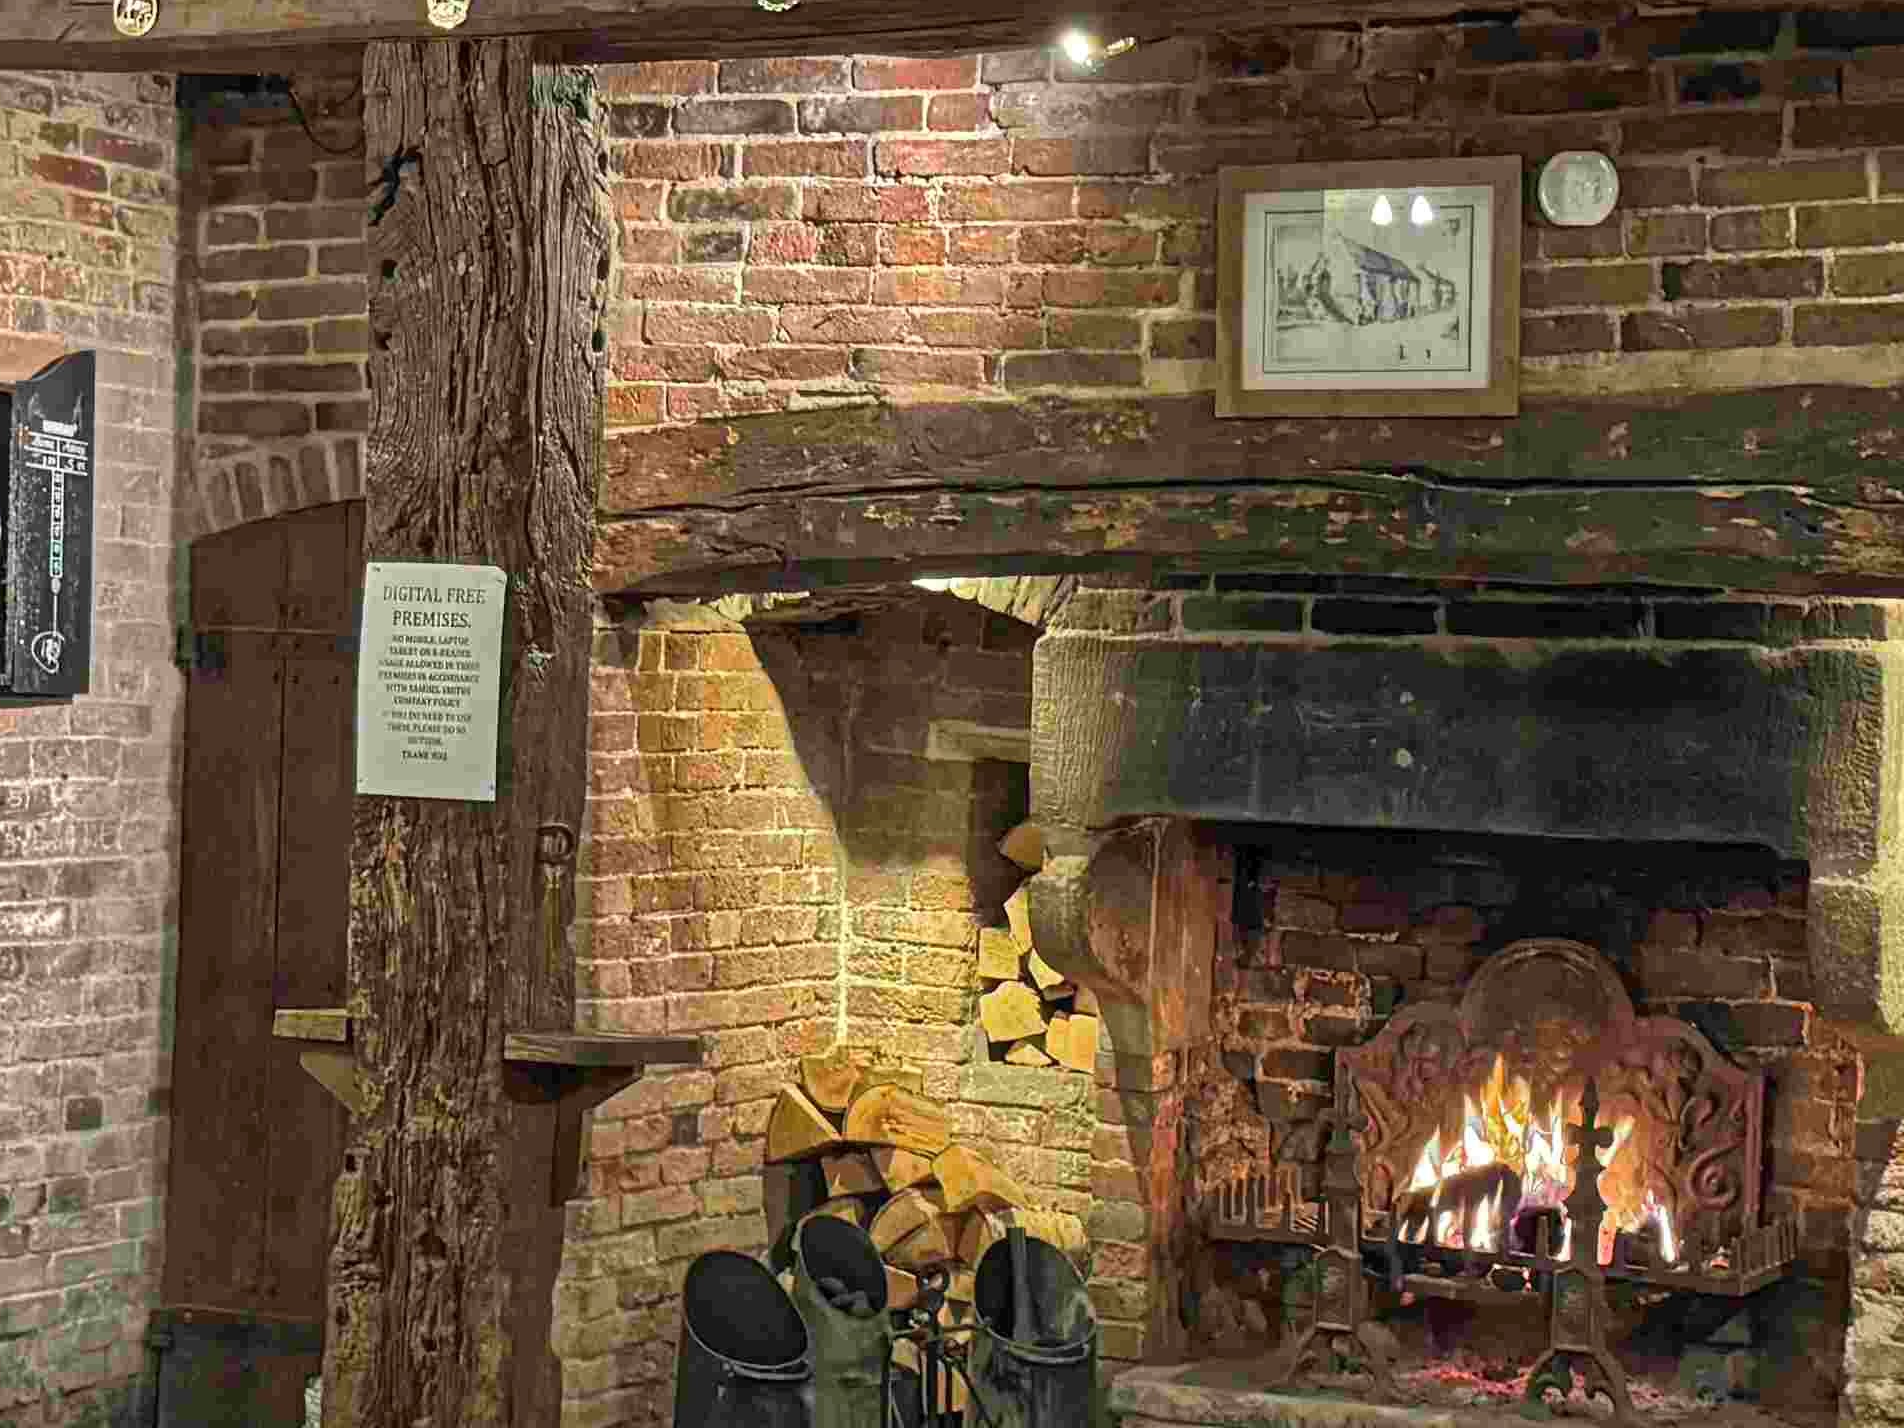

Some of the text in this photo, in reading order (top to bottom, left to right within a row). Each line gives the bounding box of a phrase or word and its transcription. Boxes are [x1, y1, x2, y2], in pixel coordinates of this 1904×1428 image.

[384, 584, 488, 605] DIGITAL FREE
[392, 609, 472, 629] PREMISES.
